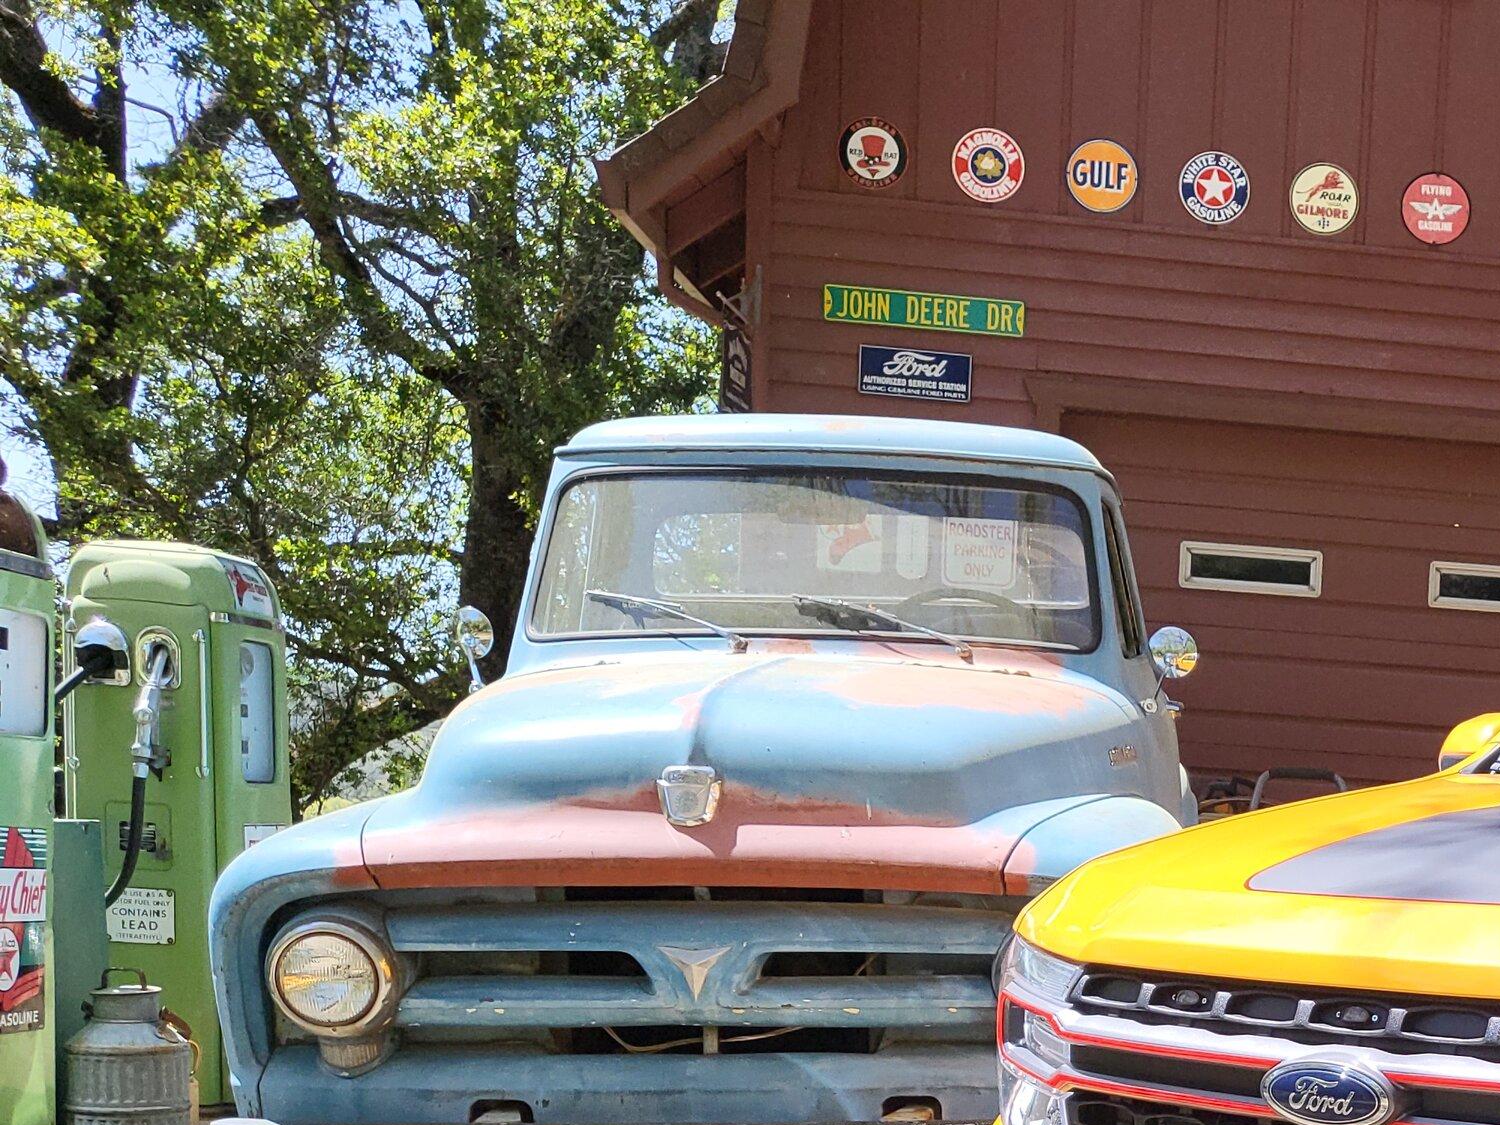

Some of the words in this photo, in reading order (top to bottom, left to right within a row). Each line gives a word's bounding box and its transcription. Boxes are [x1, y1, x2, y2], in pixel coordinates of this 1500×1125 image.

[849, 148, 863, 156] RED
[957, 131, 1019, 164] MAGNOLIA
[1072, 159, 1129, 193] GULF
[1183, 154, 1216, 184] WHITE
[1218, 156, 1247, 188] STAR
[960, 171, 1017, 199] GASOLINE
[1421, 184, 1453, 197] FLYING
[1319, 191, 1352, 203] ROAR
[1186, 196, 1242, 221] GASOLINE
[1296, 204, 1350, 220] GILMORE
[1417, 220, 1454, 233] GASOLINE
[837, 289, 891, 321] JOHN
[906, 296, 971, 328] DEERE
[986, 303, 1013, 331] DR
[882, 350, 948, 377] Ford
[862, 375, 907, 386] AUTHORIZED
[908, 379, 938, 389] SERVICE
[938, 382, 967, 392] STATION
[950, 522, 1012, 540] ROADSTER
[953, 543, 1007, 559] PARKING
[963, 563, 994, 578] ONLY
[11, 871, 47, 915] Chief
[111, 908, 167, 918] CONTAINS
[121, 919, 158, 931] LEAD
[0, 1010, 39, 1027] ASOLINE
[1288, 1076, 1355, 1116] Ford
